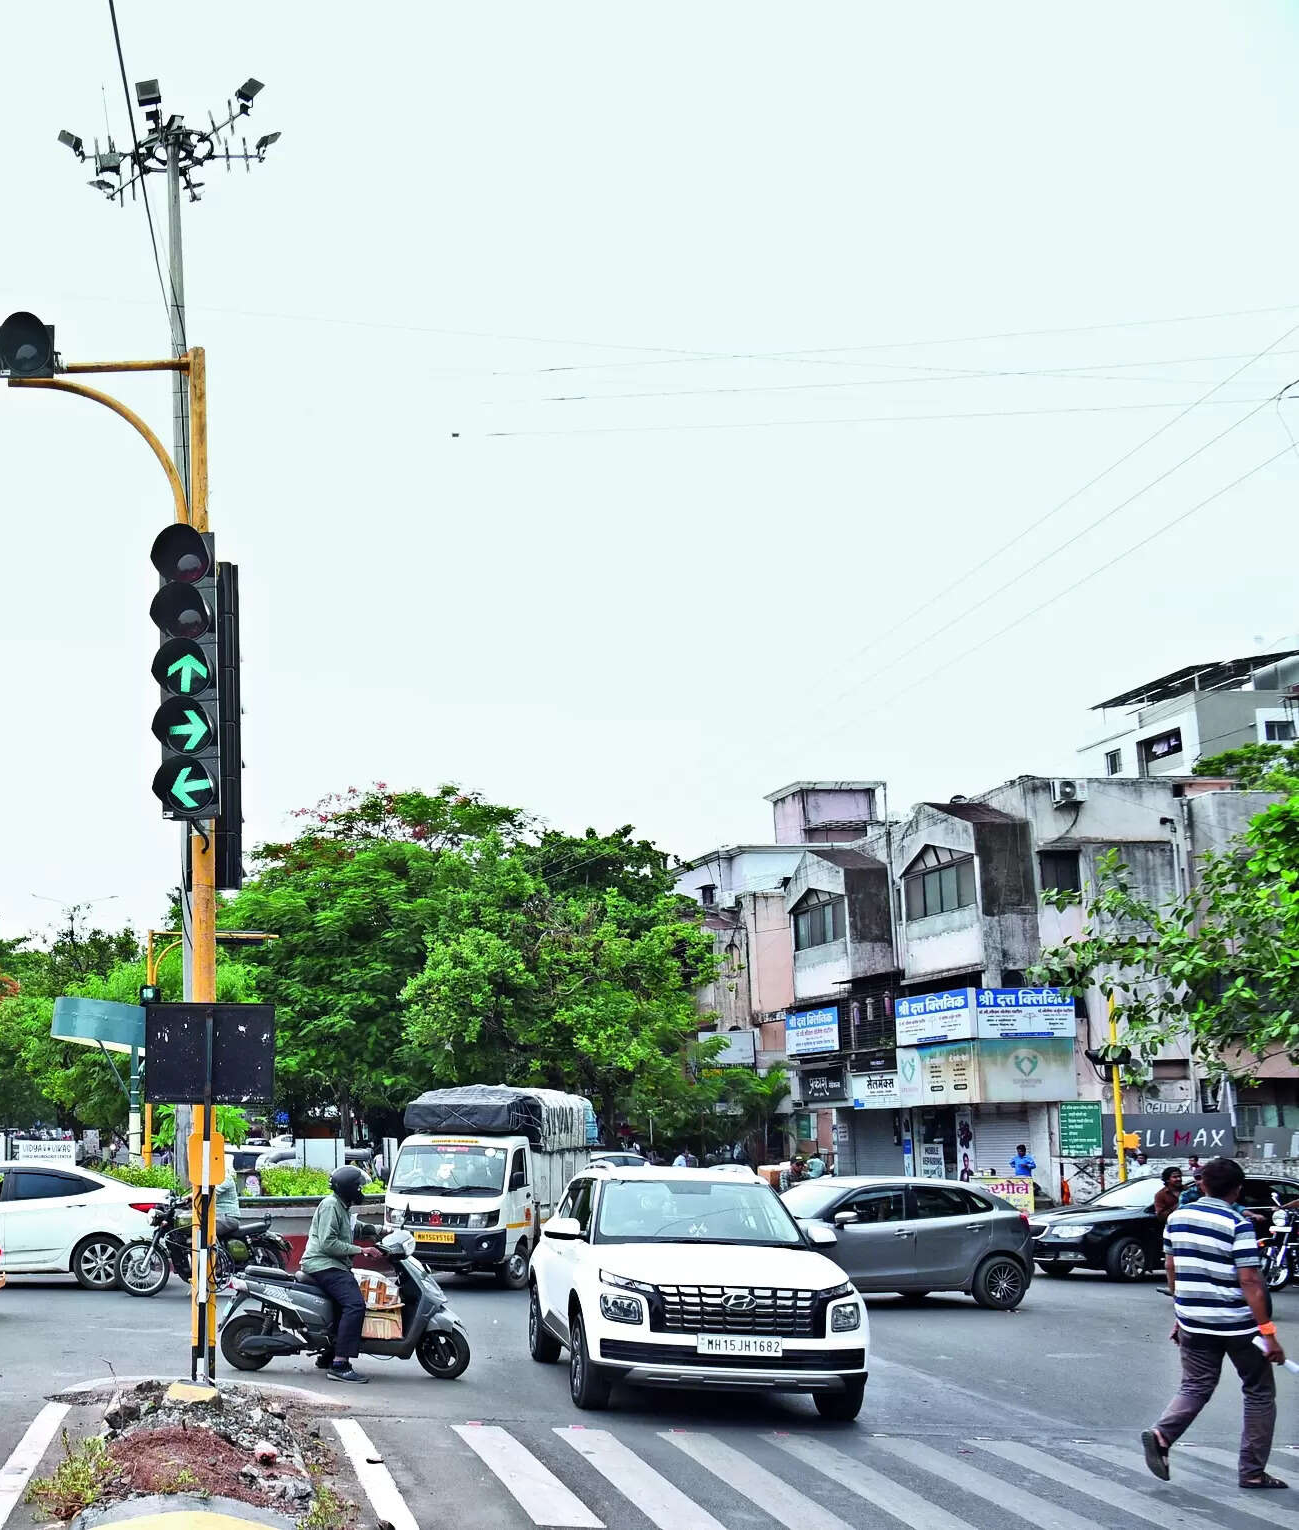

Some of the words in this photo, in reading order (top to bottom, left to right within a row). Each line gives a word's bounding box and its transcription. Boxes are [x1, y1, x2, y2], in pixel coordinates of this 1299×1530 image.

[898, 1000, 909, 1016] श्री
[925, 993, 965, 1012] क्लिनिक
[979, 990, 994, 1006] श्री
[996, 994, 1016, 1006] दत्त
[1113, 1129, 1226, 1148] LLMAX
[987, 1180, 1029, 1195] रभोले
[707, 1338, 780, 1353] MH15JH1682
